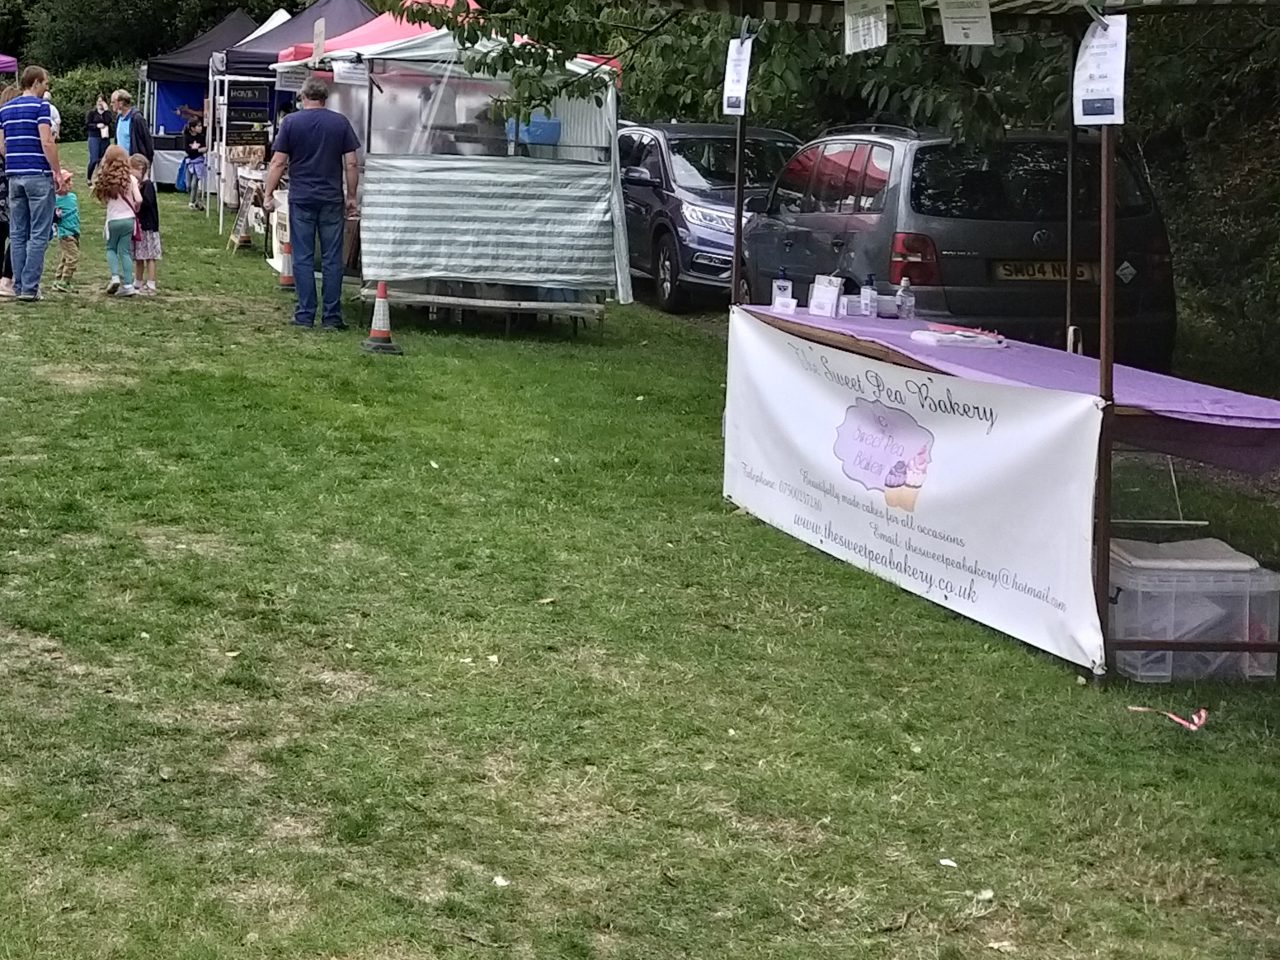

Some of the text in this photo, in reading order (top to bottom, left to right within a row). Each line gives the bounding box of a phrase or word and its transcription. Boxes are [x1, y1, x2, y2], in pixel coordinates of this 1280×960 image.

[820, 356, 865, 394] Sweet
[865, 369, 906, 406] Pea
[905, 379, 998, 435] Bakery
[793, 513, 979, 604] www.thesweetpeabakery.co.uk
[861, 502, 885, 519] cakes
[885, 507, 900, 527] for
[901, 512, 915, 529] all
[917, 524, 966, 548] occasions
